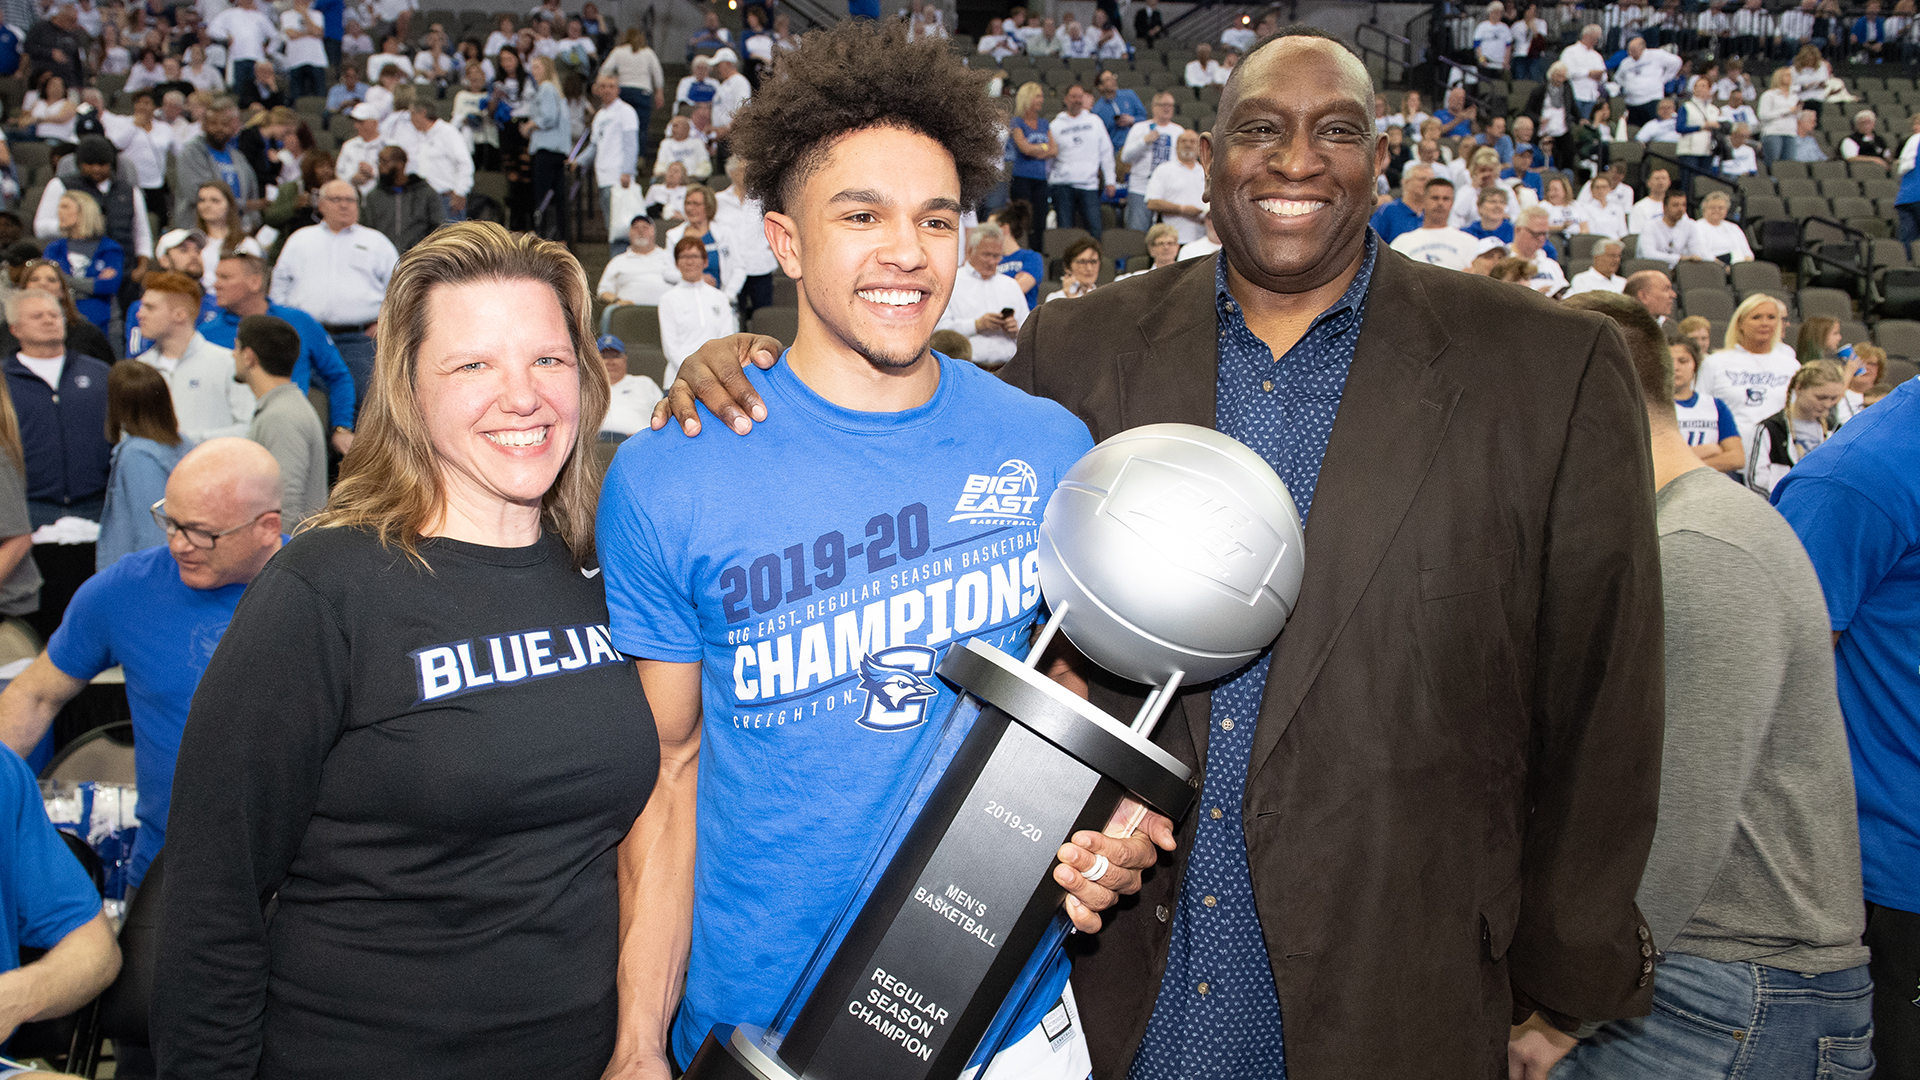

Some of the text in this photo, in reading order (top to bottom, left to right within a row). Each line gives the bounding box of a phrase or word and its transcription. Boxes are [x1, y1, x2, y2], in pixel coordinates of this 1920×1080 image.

[954, 493, 1040, 514] EAST
[963, 474, 1023, 496] BIG
[969, 518, 1037, 526] BASKETBALL
[720, 502, 931, 624] 2019-20
[728, 623, 751, 645] BIG
[758, 610, 797, 637] EAST
[806, 580, 882, 620] REGULAR
[890, 557, 954, 590] SEASON
[732, 549, 1042, 702] CHAMPIONS
[733, 689, 853, 730] CREIGHTON
[984, 800, 1043, 844] 2019-20
[914, 887, 997, 949] BASKETBALL
[945, 884, 988, 918] MEN'S
[867, 989, 935, 1039] SEASON
[871, 967, 949, 1026] REGULAR
[848, 1001, 934, 1062] CHAMPION
